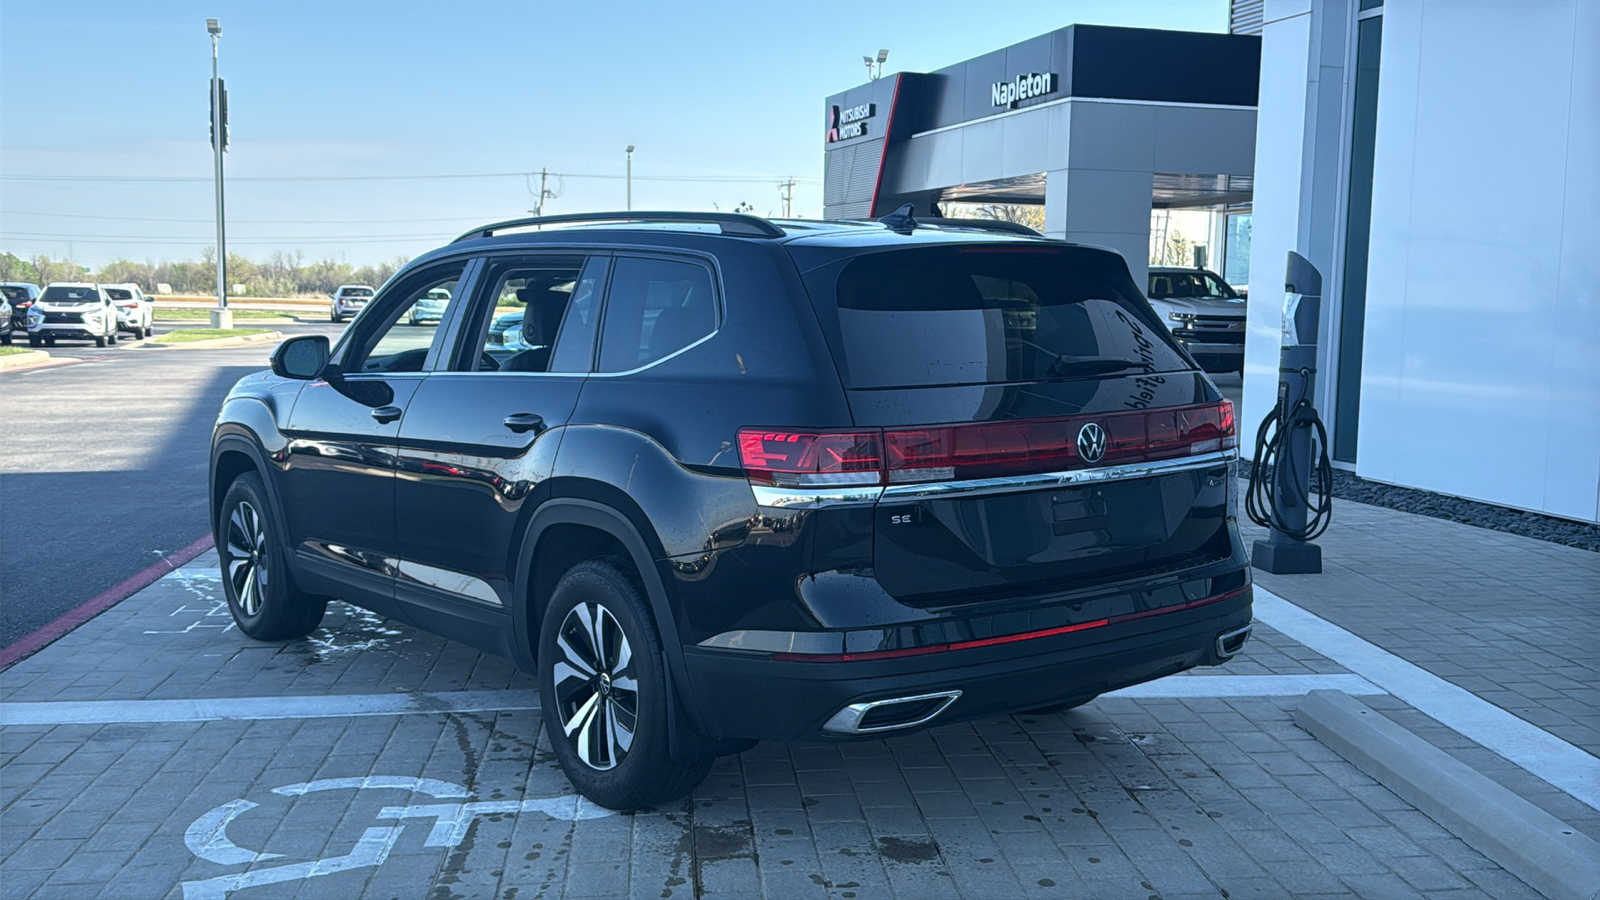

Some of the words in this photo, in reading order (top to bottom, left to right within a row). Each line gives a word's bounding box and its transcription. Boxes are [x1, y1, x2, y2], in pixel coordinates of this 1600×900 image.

[991, 72, 1051, 108] Napleton
[840, 103, 870, 124] MITSUBISHI
[839, 122, 862, 140] MOTORS
[891, 514, 911, 524] SE
